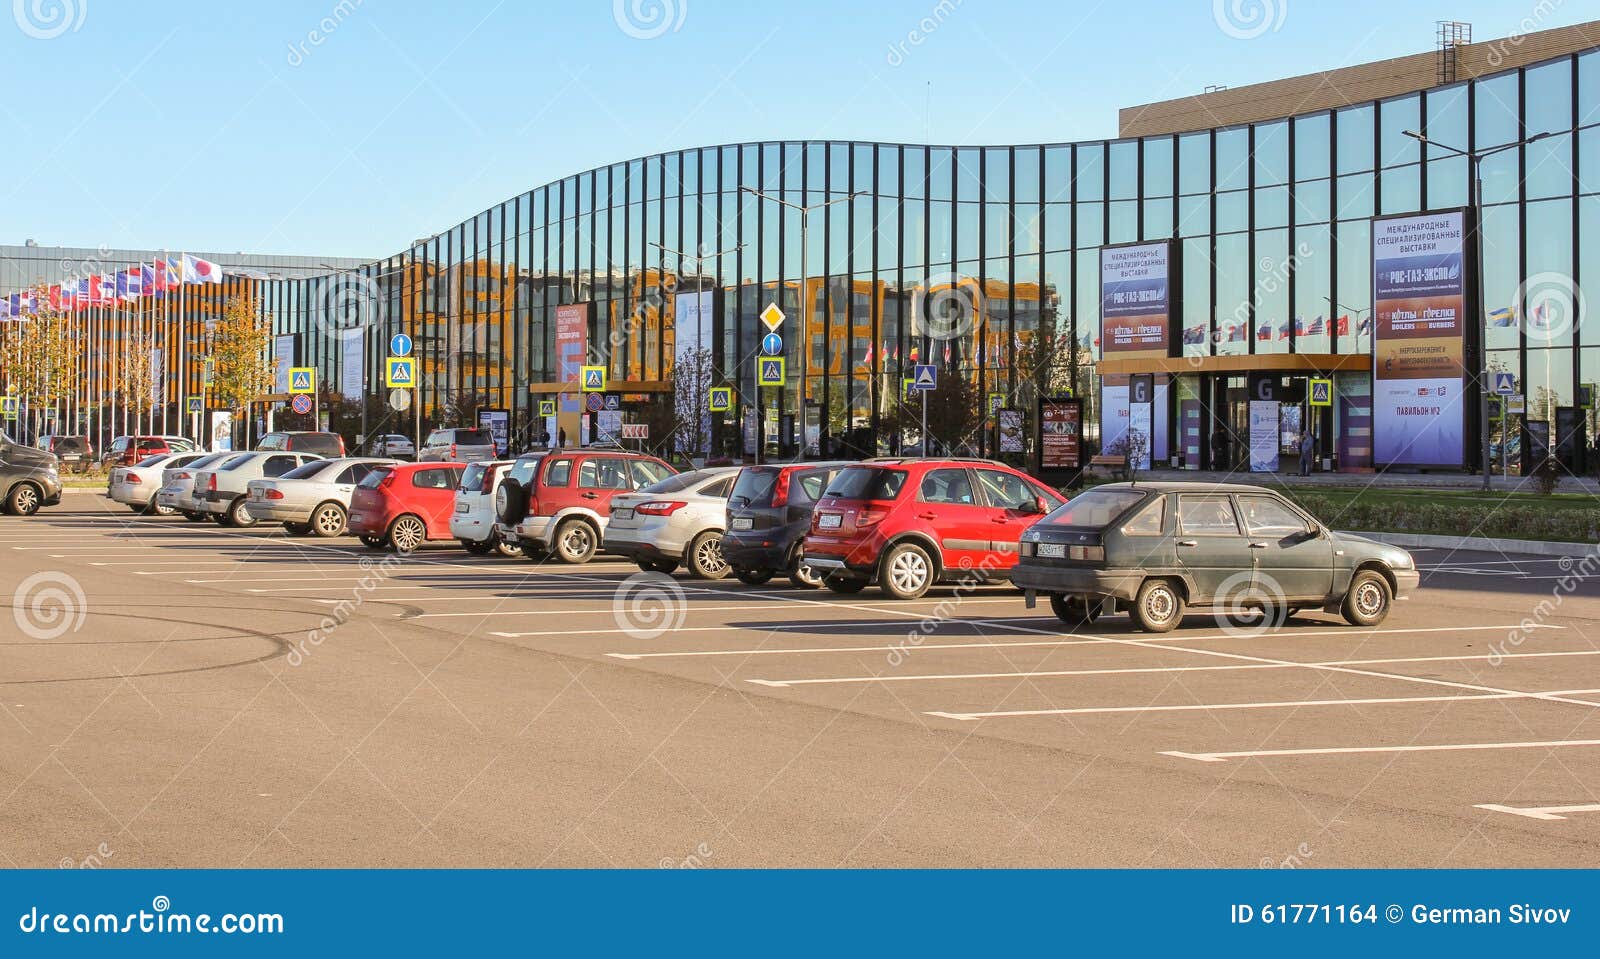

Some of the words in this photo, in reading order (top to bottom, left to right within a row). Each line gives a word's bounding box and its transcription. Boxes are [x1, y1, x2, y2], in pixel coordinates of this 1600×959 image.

[1386, 220, 1450, 234] МЕЖДУНАРОДНЫЕ
[1377, 230, 1460, 245] СПЕЦИАЛИЗИРОВАННЫЕ
[1400, 243, 1436, 253] ВЫСТАВКИ
[1423, 307, 1455, 319] ГОРЕЛКИ
[1135, 382, 1145, 402] G
[1258, 378, 1273, 400] G
[1396, 406, 1429, 416] ПАВИЛЬОН
[1431, 406, 1440, 416] №2
